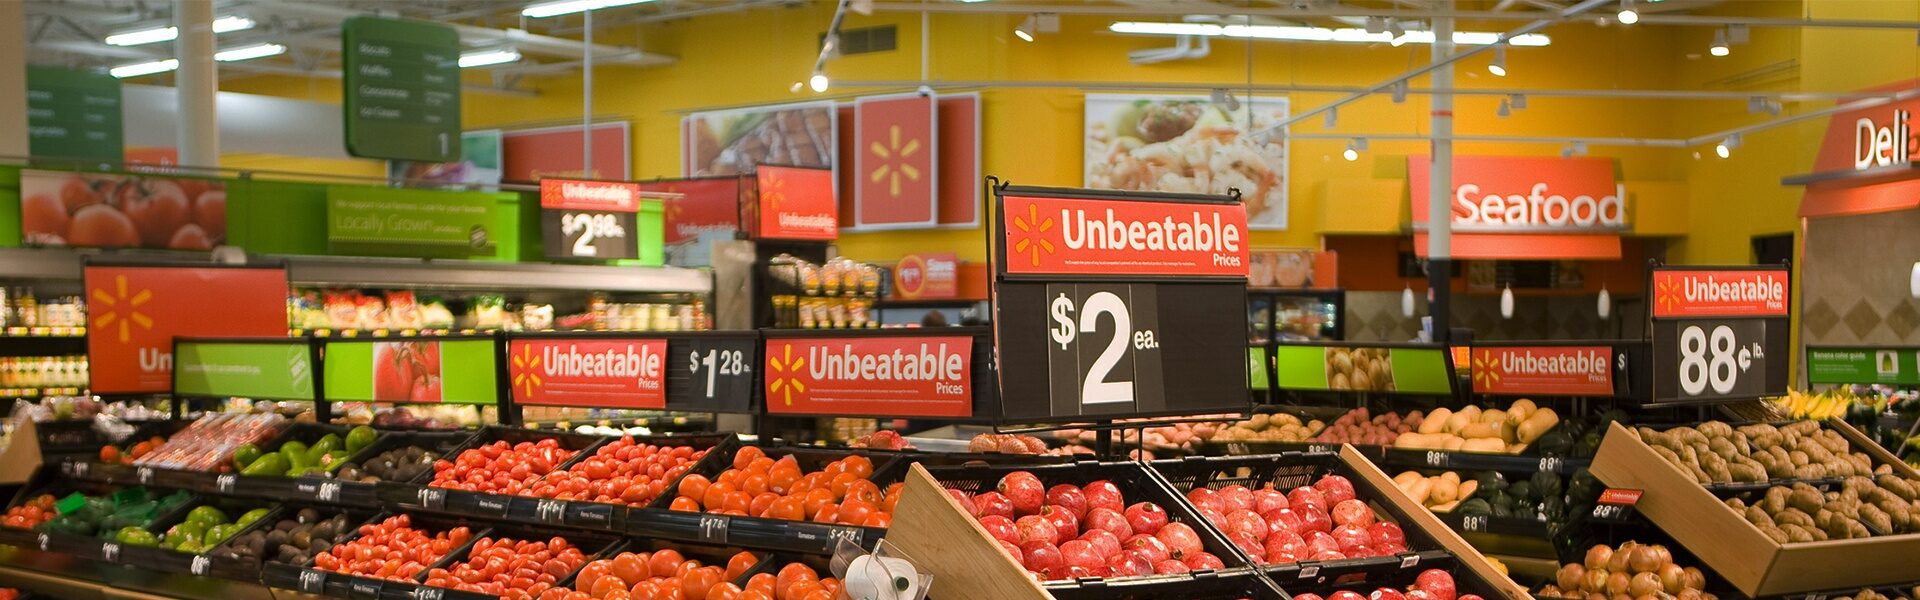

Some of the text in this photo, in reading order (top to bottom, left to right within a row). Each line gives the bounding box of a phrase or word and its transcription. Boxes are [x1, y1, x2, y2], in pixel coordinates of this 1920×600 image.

[1855, 108, 1908, 170] Deli
[1455, 182, 1626, 227] Seafood
[336, 214, 384, 232] Locally
[1062, 208, 1240, 252] Unbeatable
[1213, 253, 1241, 267] Prices
[1684, 275, 1783, 302] Unbeatable
[543, 344, 661, 378] Unbeatable
[809, 343, 963, 381] Unbeatable
[1051, 291, 1134, 404] $2
[1502, 350, 1606, 375] Unbeatable
[638, 377, 659, 390] Prices
[936, 382, 964, 395] Prices
